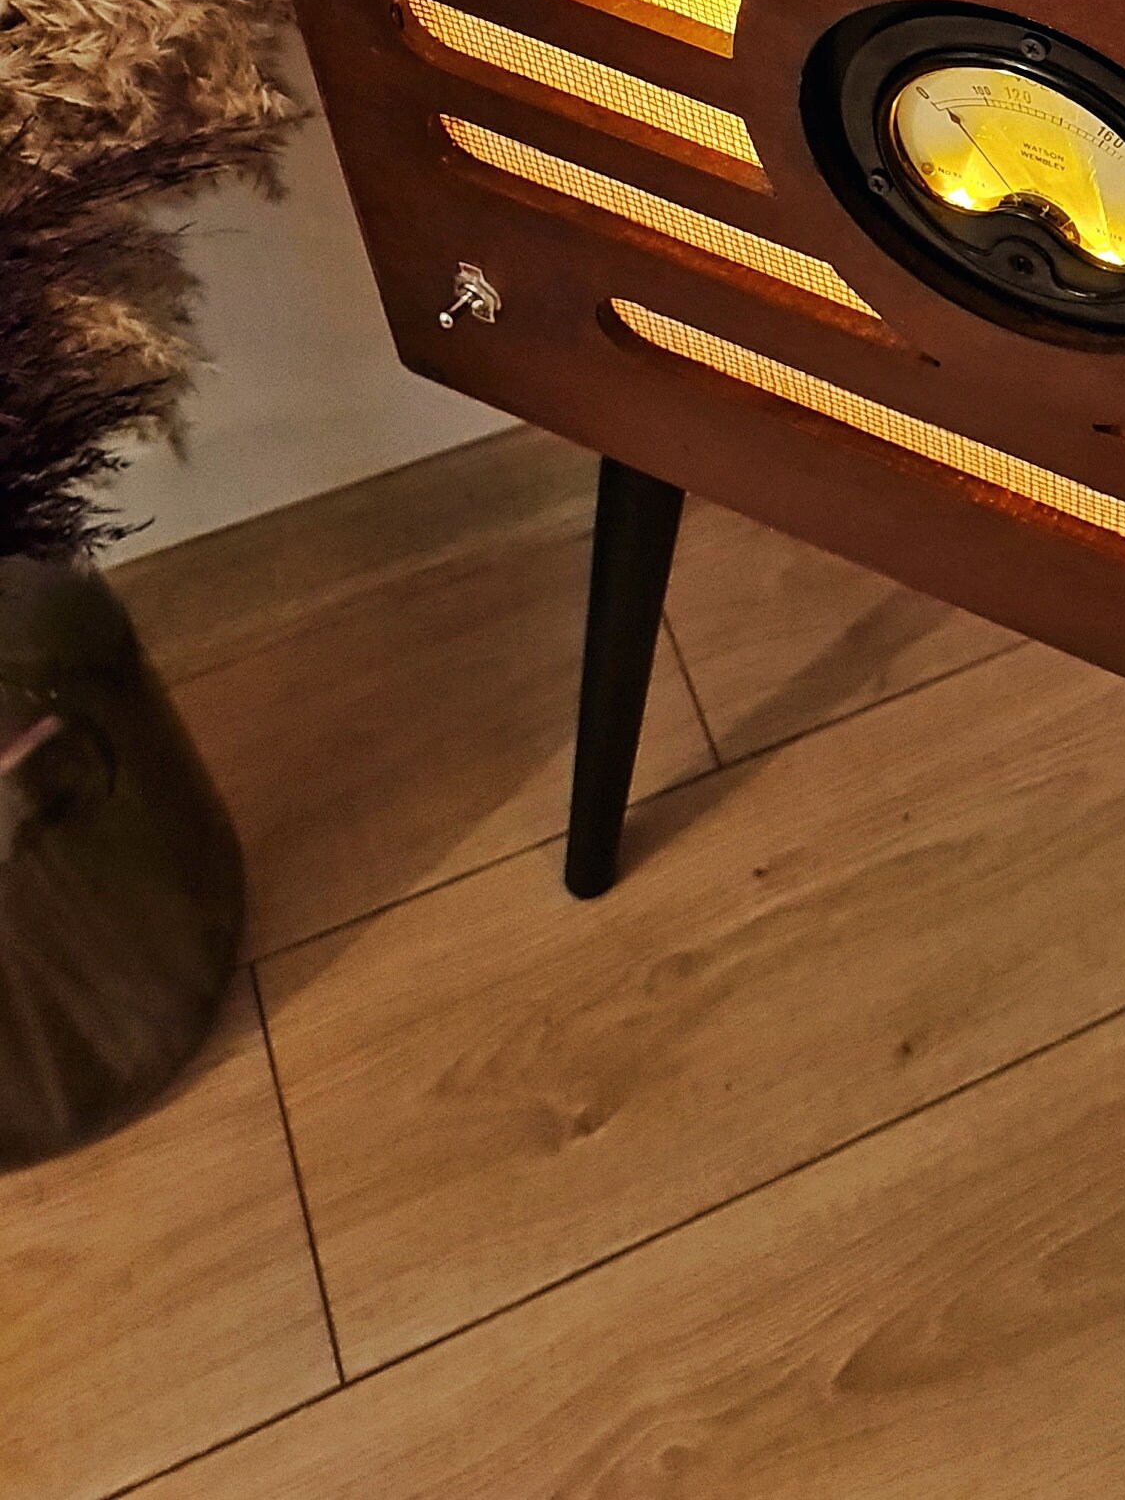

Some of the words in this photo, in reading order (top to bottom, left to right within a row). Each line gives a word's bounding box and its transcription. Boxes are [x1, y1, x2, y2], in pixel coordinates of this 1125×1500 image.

[916, 86, 930, 100] 0
[972, 85, 991, 96] 100
[1004, 86, 1032, 104] 120
[1020, 150, 1066, 171] WEMBLEY
[1022, 142, 1065, 162] WATSON
